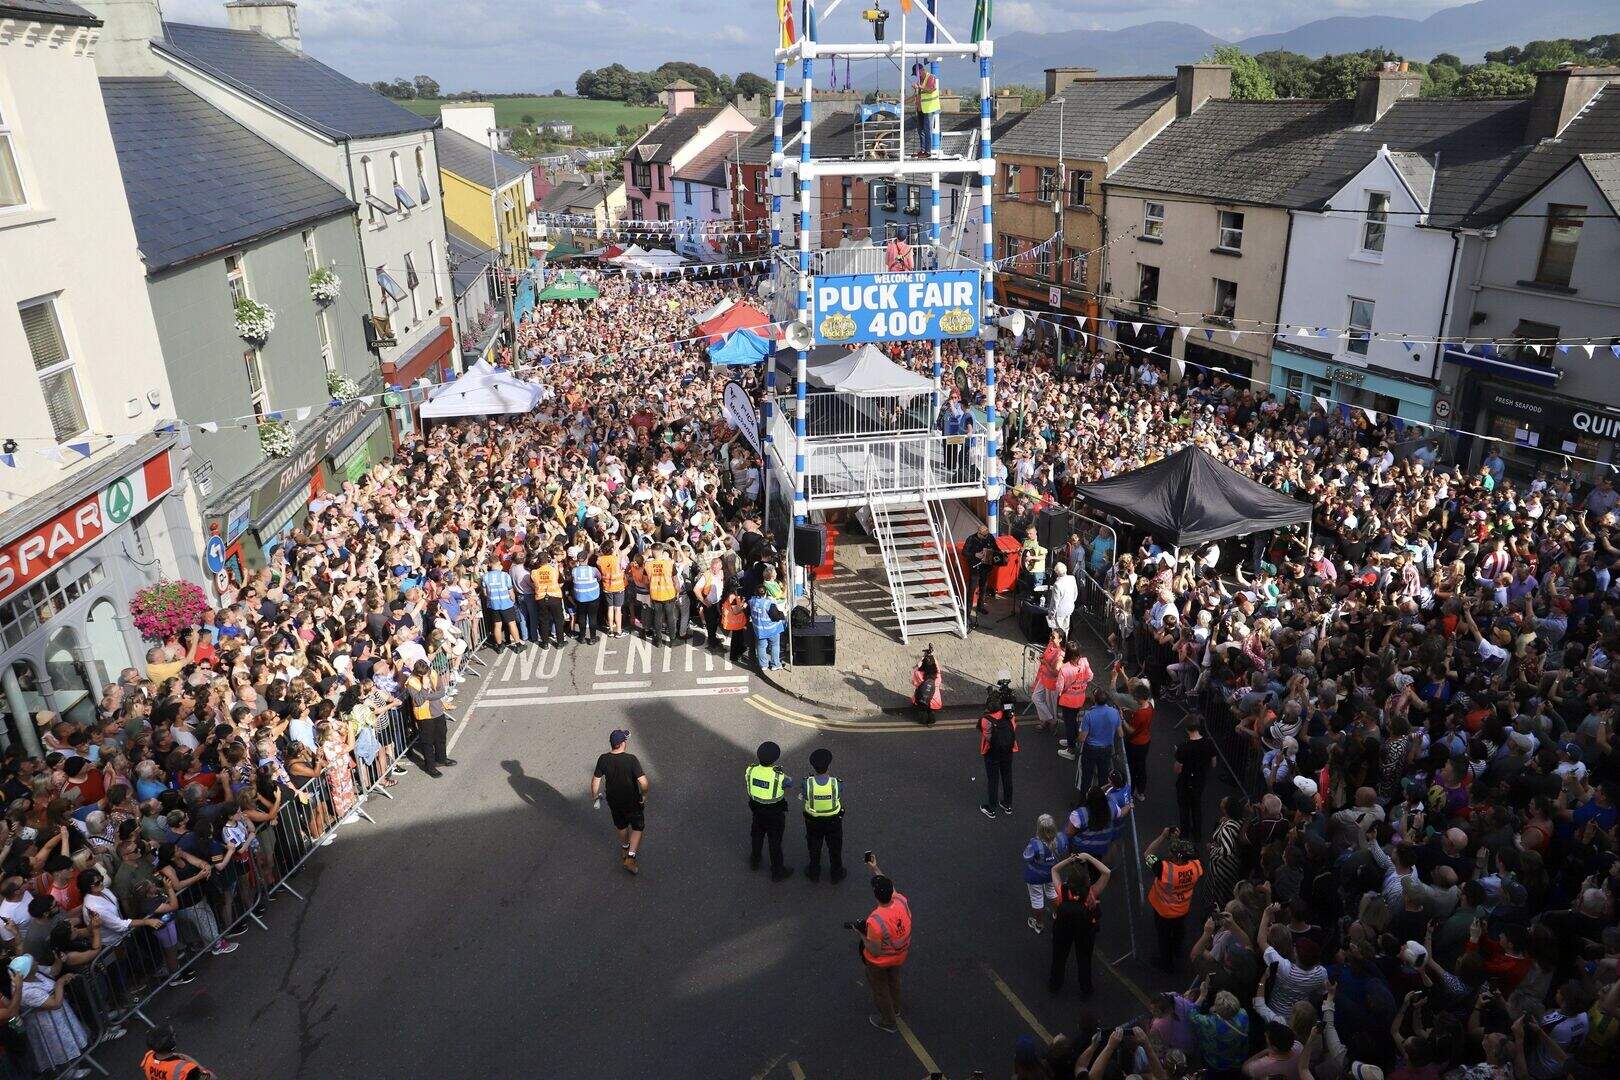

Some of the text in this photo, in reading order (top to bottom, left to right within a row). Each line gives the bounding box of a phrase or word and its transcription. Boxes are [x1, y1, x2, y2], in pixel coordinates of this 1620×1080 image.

[874, 273, 927, 284] WELCOME TO
[819, 281, 974, 312] PUCK FAIR
[1495, 396, 1543, 413] FRESH SEAFOOD
[0, 502, 101, 592] SPAR
[501, 643, 565, 682] NO
[150, 1067, 168, 1078] PUCK
